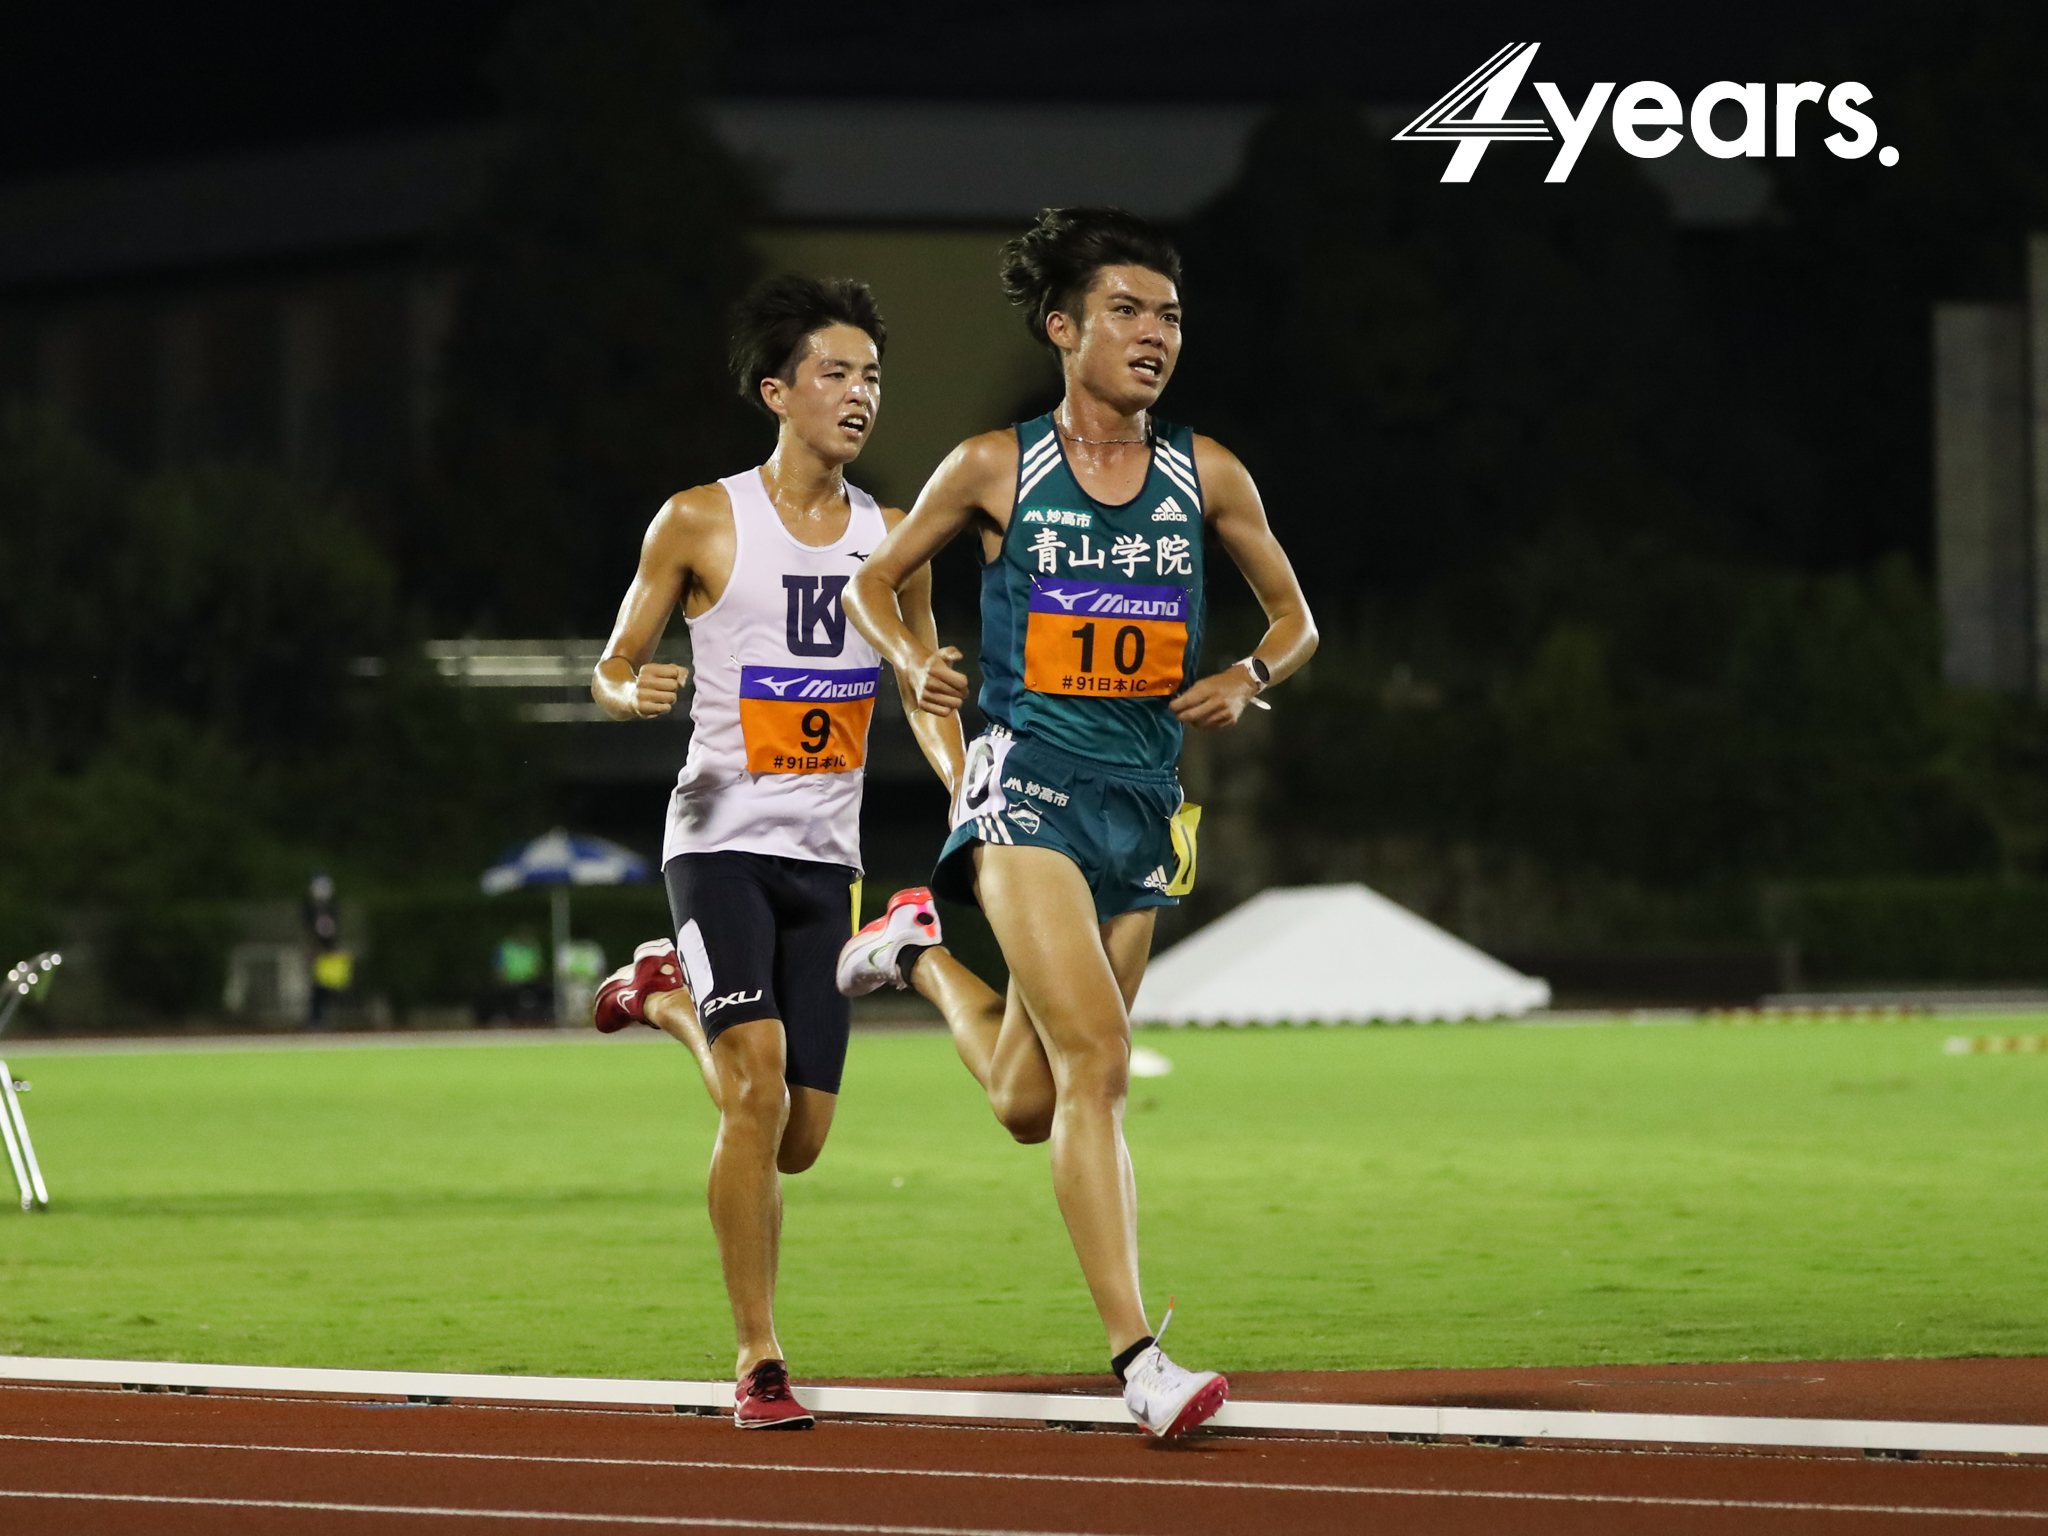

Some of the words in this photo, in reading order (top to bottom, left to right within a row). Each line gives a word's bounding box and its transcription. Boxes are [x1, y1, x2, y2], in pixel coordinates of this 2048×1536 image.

[1046, 508, 1092, 528] 妙高市
[1151, 510, 1188, 522] adidas
[1027, 527, 1193, 578] 青山学院
[1072, 622, 1146, 675] 10
[800, 708, 831, 753] 9
[1024, 781, 1070, 807] 妙高市
[704, 989, 763, 1018] 2XU
